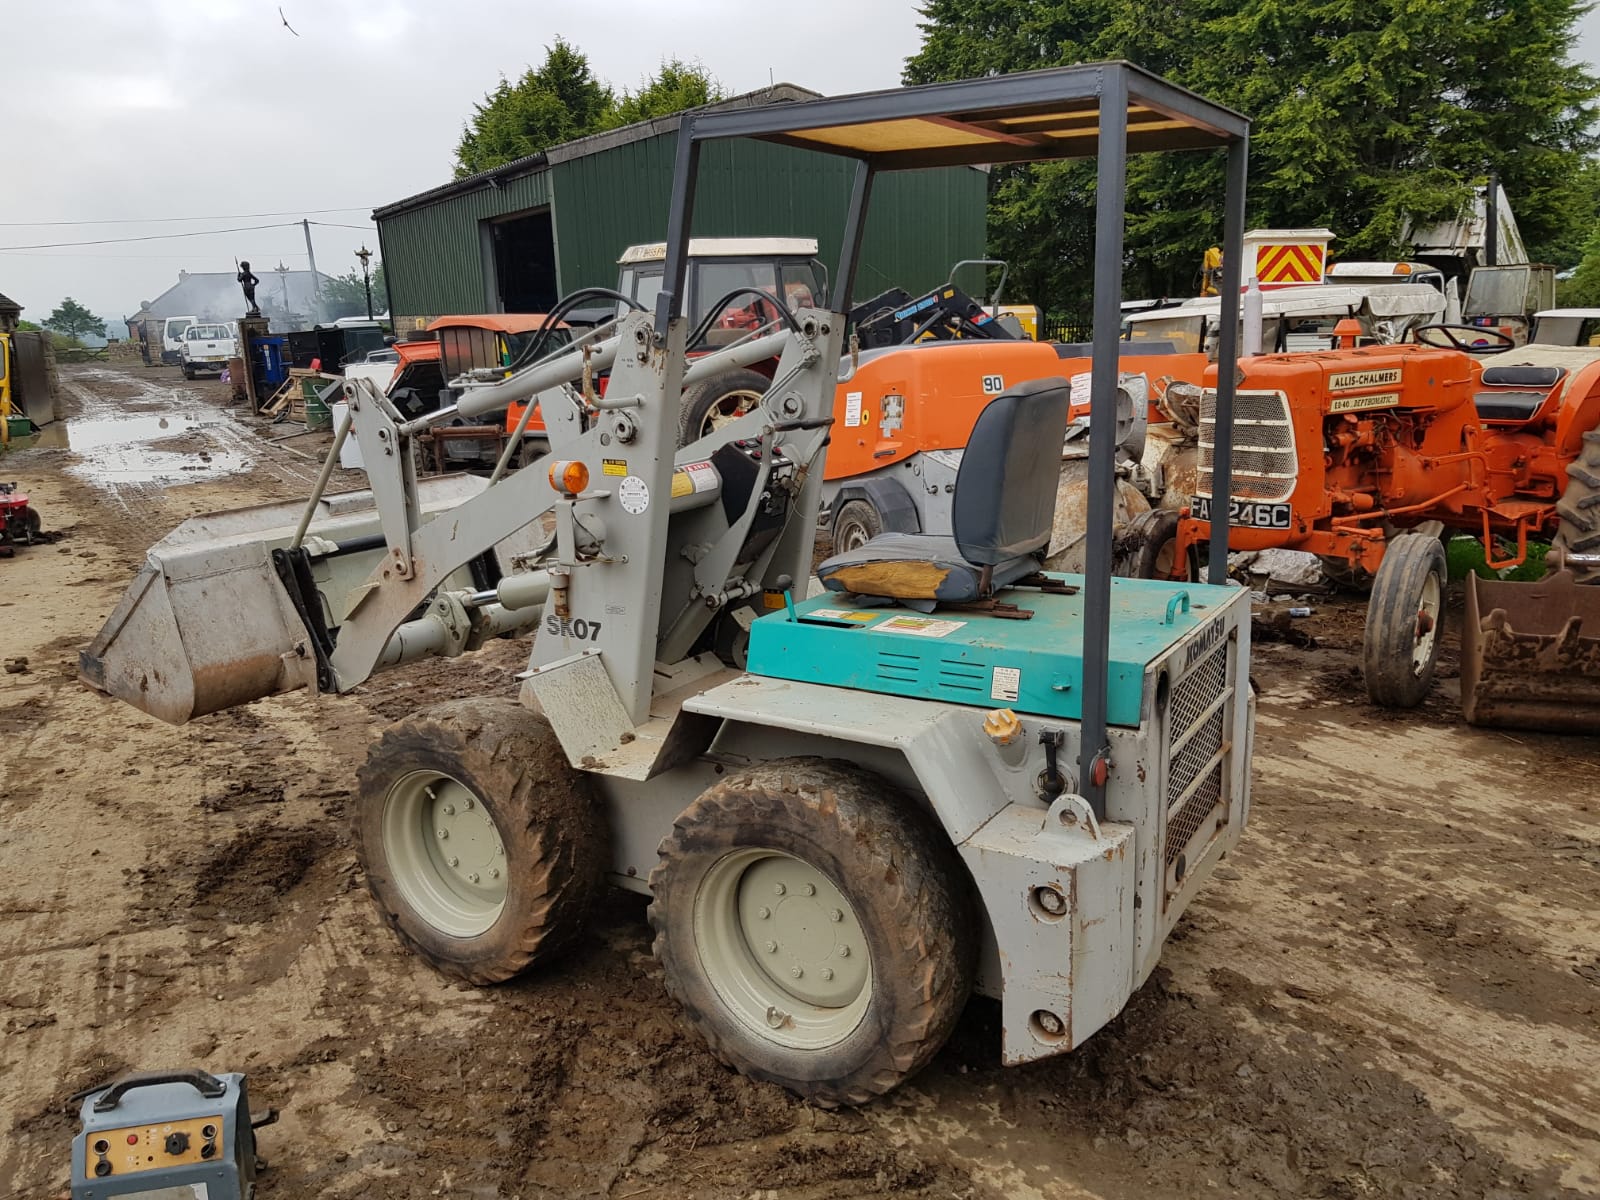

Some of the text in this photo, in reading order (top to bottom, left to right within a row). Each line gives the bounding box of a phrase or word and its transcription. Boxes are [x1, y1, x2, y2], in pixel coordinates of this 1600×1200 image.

[984, 377, 1002, 391] 90
[1334, 371, 1398, 388] ALLIS-CHALMERS
[546, 614, 602, 641] SK07
[1186, 615, 1225, 666] KOMATSU
